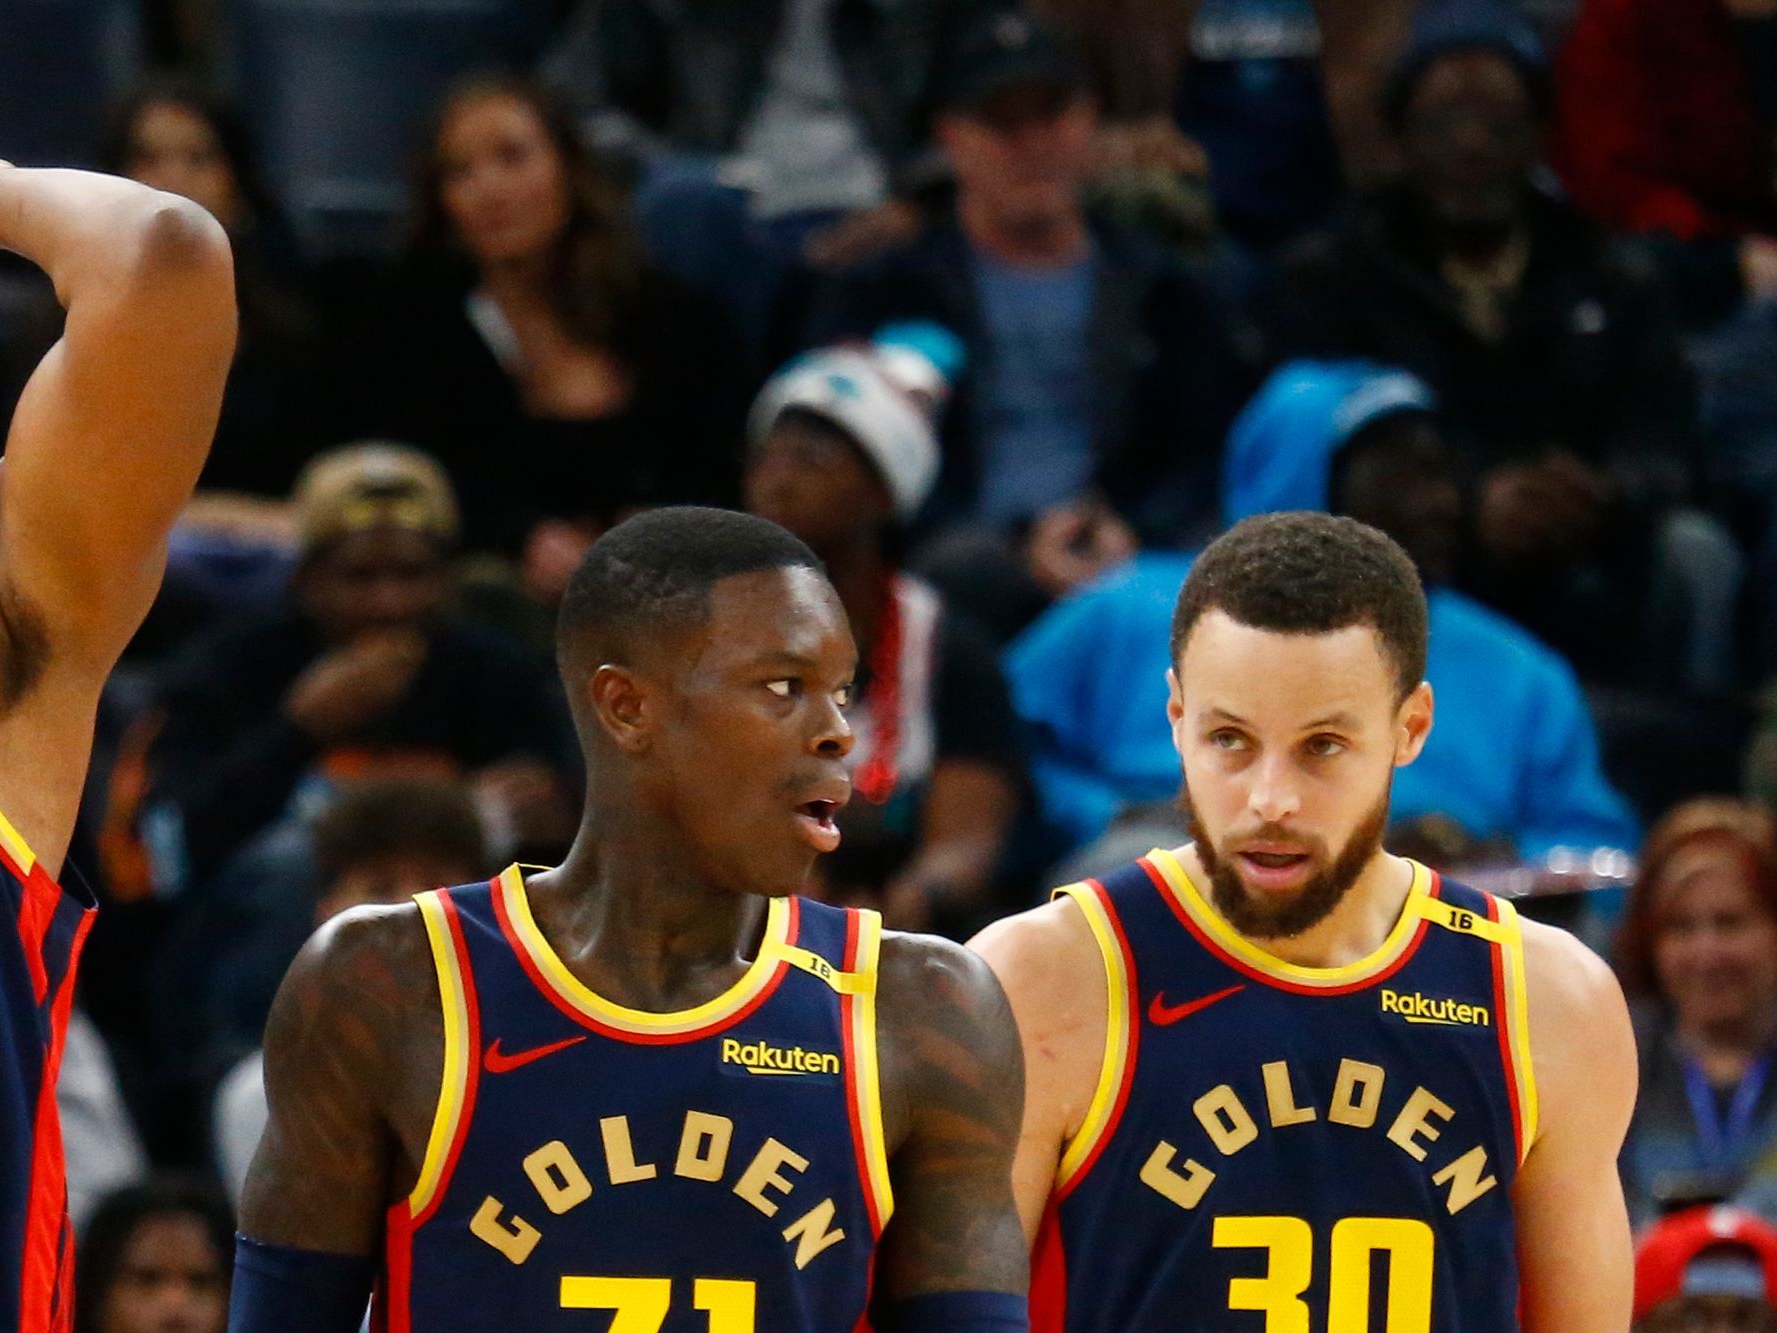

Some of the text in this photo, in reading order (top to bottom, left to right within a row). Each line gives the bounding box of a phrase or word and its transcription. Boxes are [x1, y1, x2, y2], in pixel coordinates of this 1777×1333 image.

[1449, 910, 1473, 929] 16
[1381, 989, 1489, 1027] Rakuten
[722, 1038, 840, 1075] Rakuten
[1139, 1057, 1496, 1215] GOLDEN
[469, 1110, 846, 1271] GOLDEN
